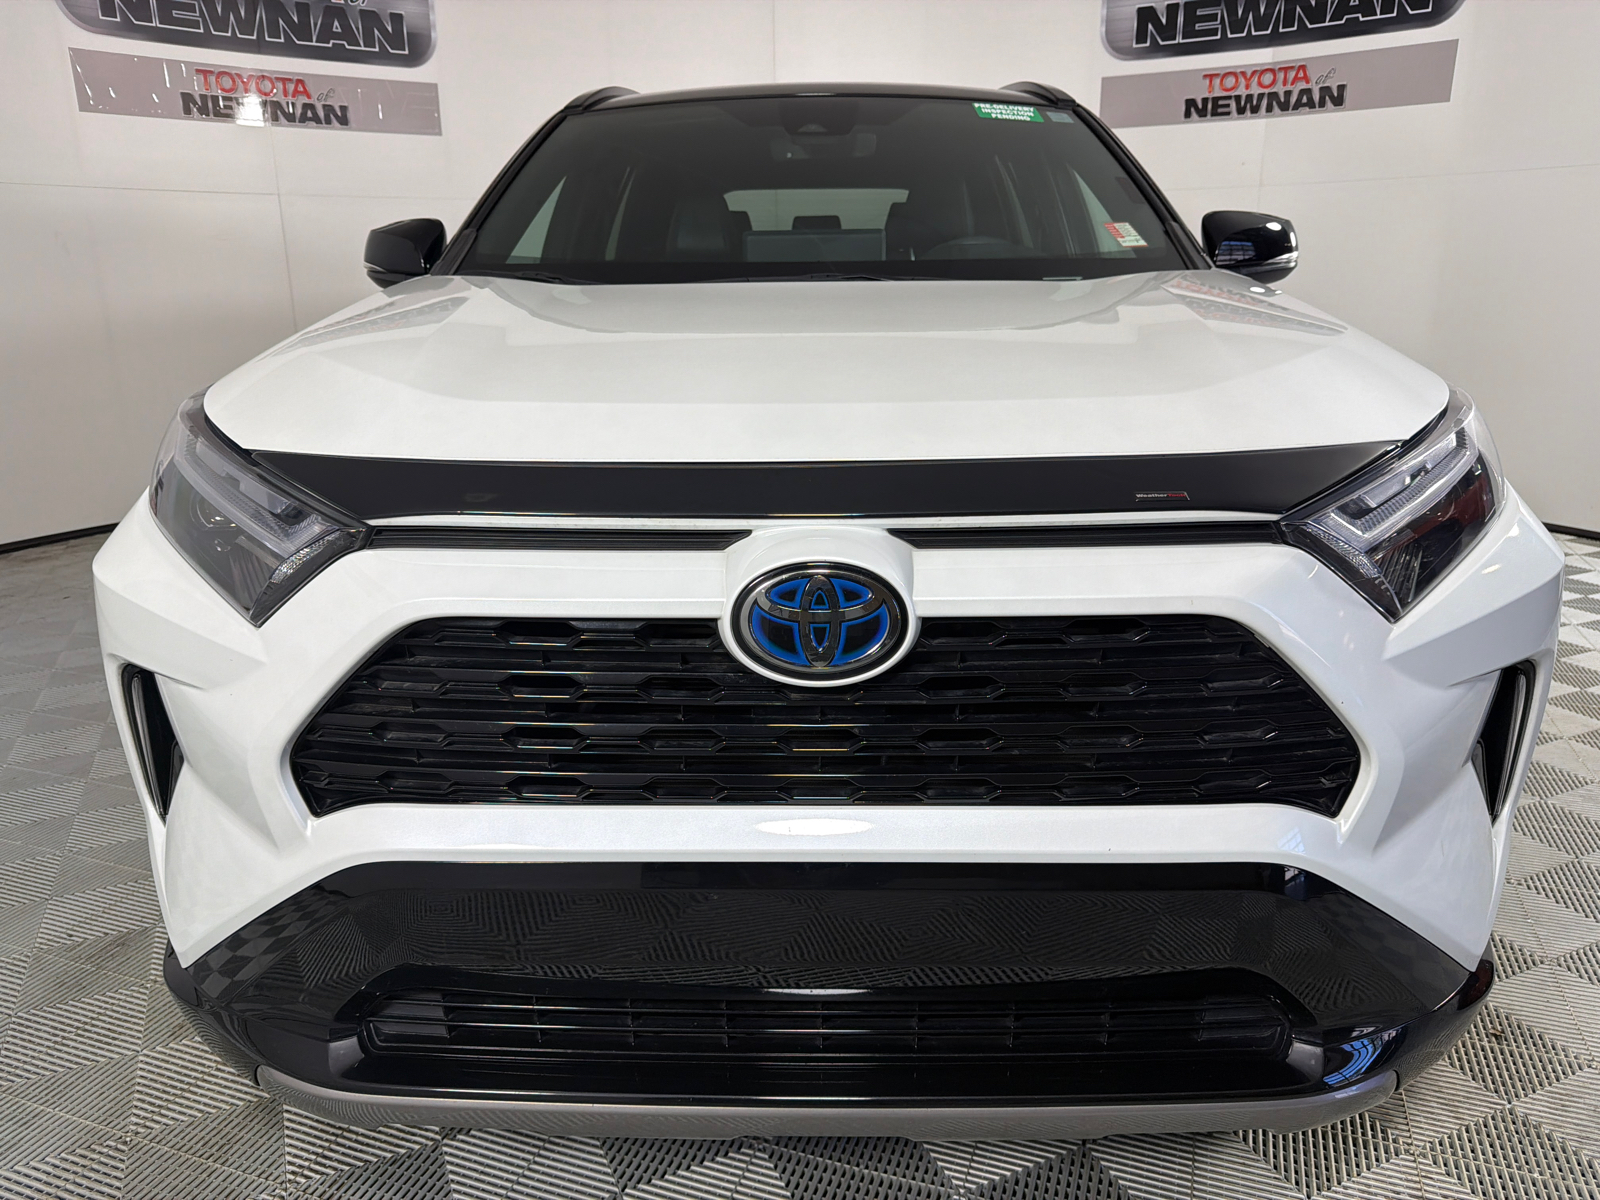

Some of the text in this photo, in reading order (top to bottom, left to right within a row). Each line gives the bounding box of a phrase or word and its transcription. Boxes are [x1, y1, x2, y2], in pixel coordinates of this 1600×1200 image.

[195, 68, 336, 103] TOYOTA of
[1203, 64, 1337, 94] TOYOTA of
[179, 91, 349, 127] NENAN
[1183, 84, 1347, 119] NEWNAN
